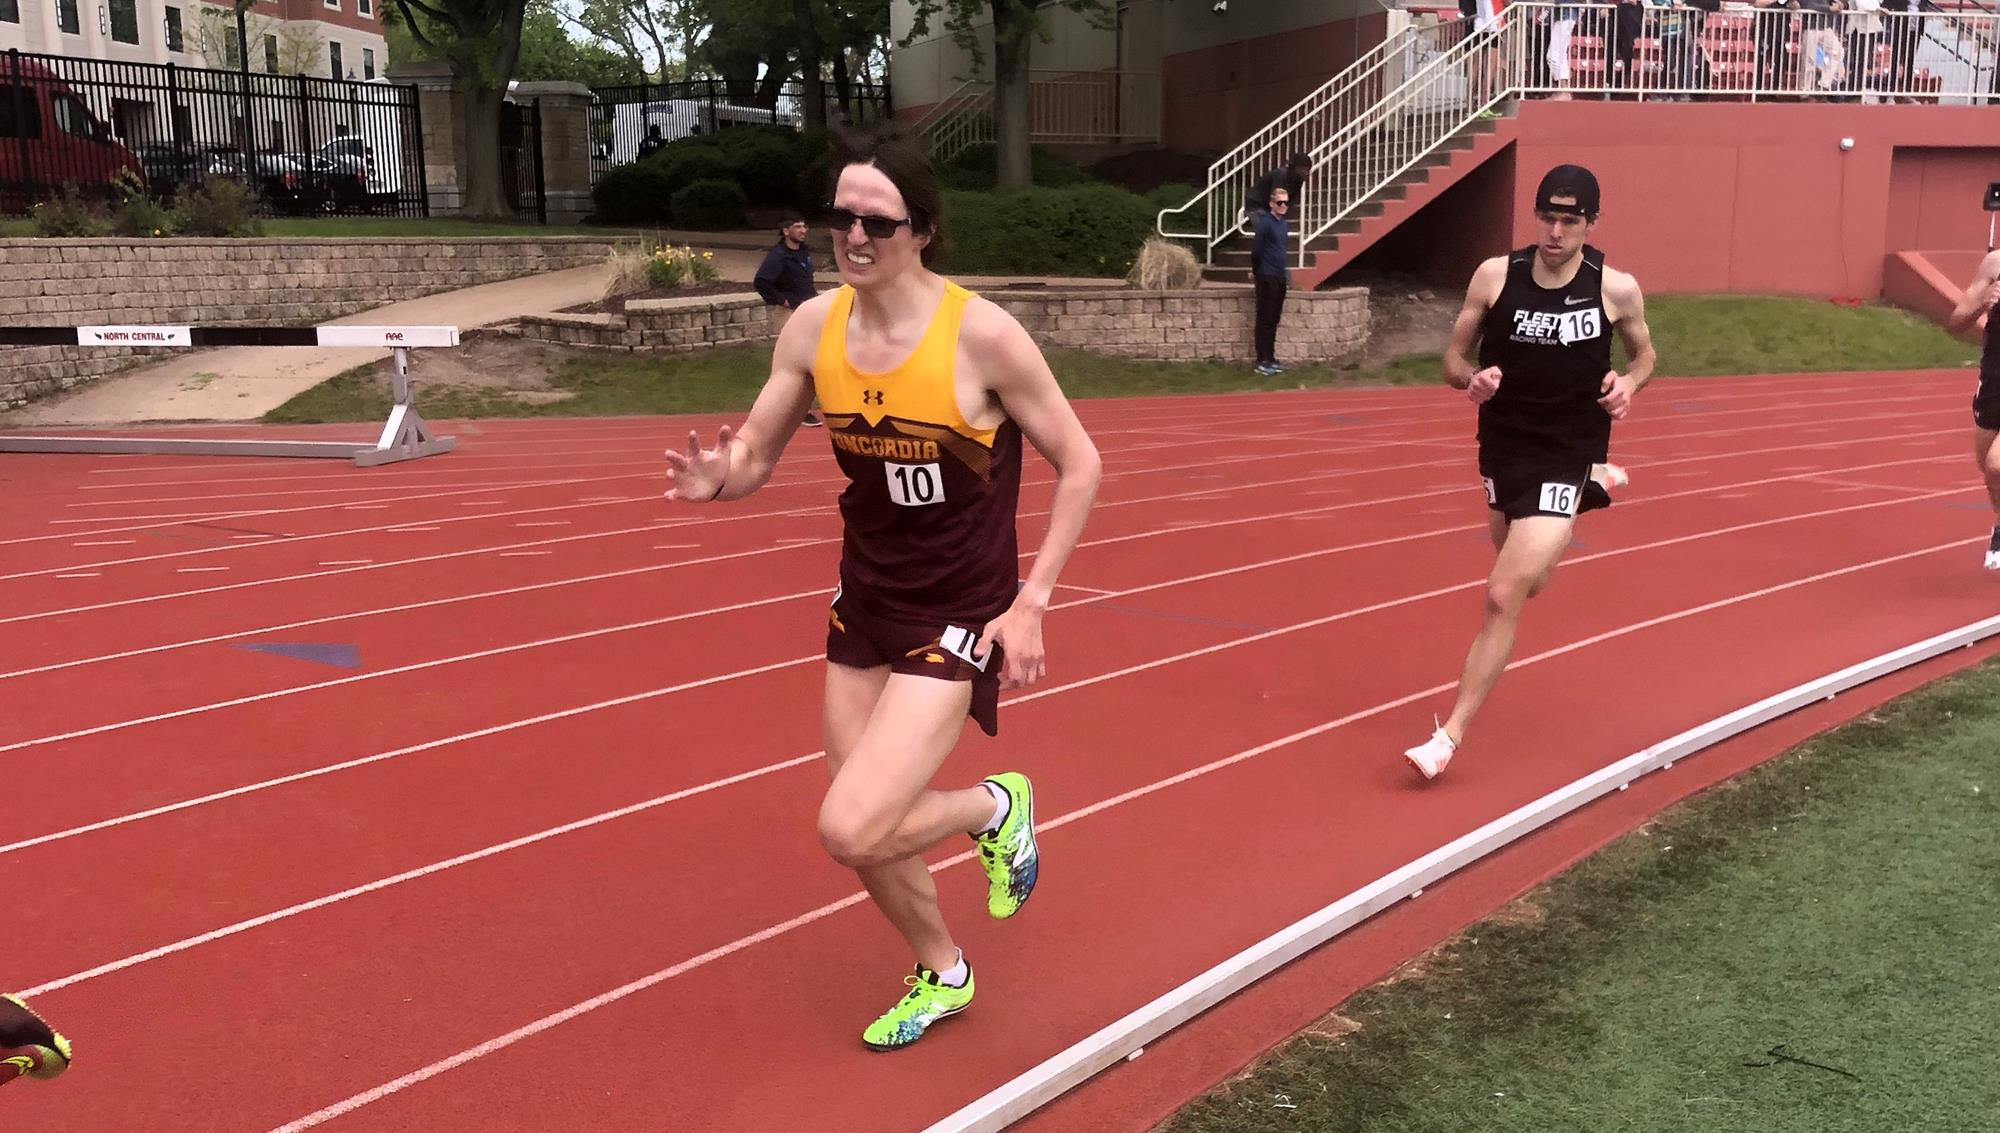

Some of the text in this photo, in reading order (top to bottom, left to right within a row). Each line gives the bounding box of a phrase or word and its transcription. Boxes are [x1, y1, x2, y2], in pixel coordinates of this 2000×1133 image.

[1513, 309, 1561, 330] FLEET
[1516, 322, 1555, 338] FEET
[1568, 311, 1594, 340] 16
[103, 332, 166, 341] NORTH CENTRAL
[1510, 334, 1558, 345] RACING TEAM
[894, 466, 934, 503] 10
[1547, 485, 1570, 512] 16
